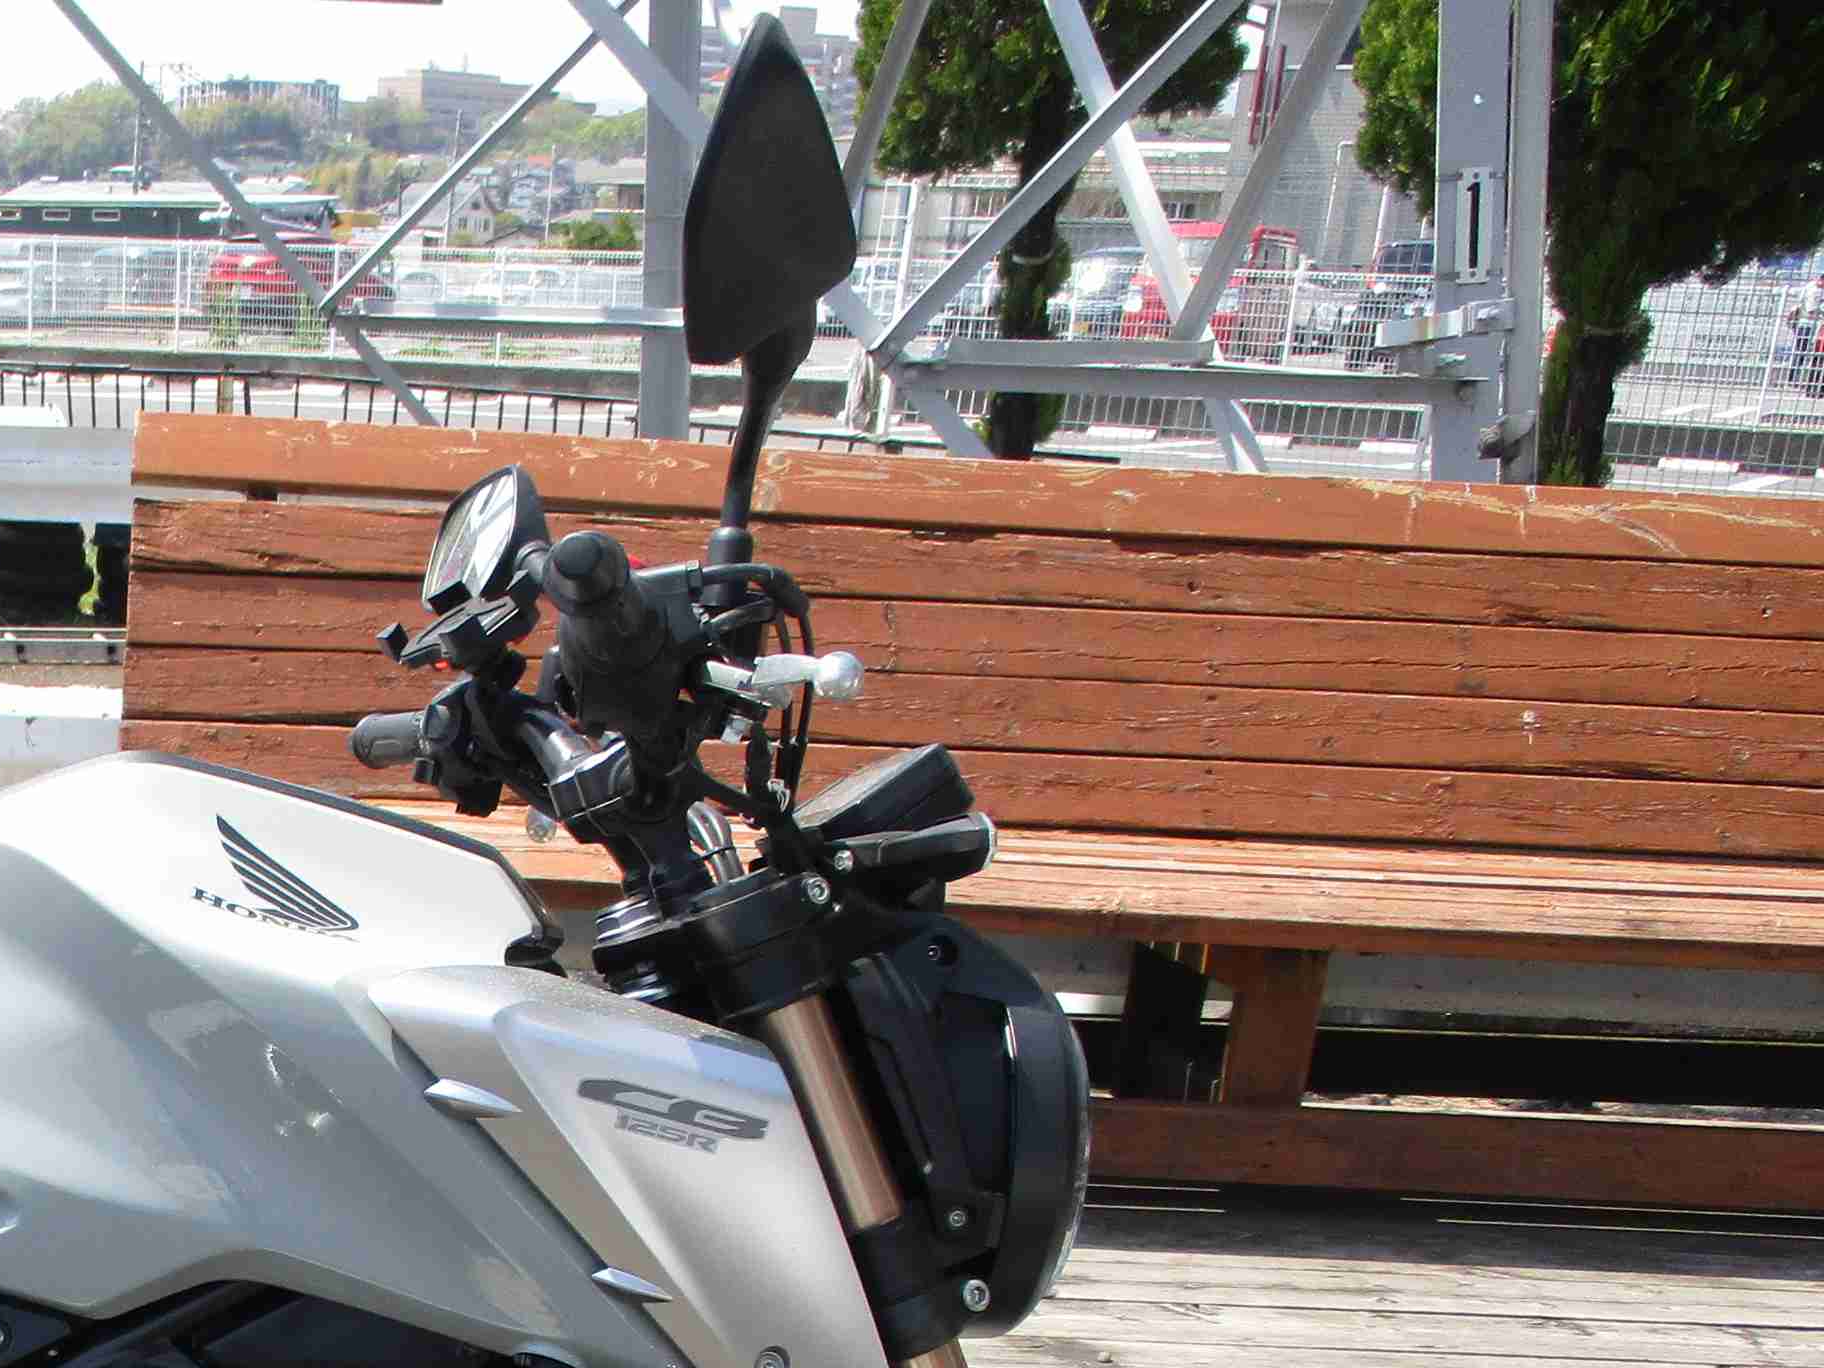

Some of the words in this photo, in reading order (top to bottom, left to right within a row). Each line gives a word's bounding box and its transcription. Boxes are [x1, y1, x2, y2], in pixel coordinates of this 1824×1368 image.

[1466, 181, 1481, 269] 1
[192, 886, 361, 943] HON
[614, 1107, 721, 1154] 125R
